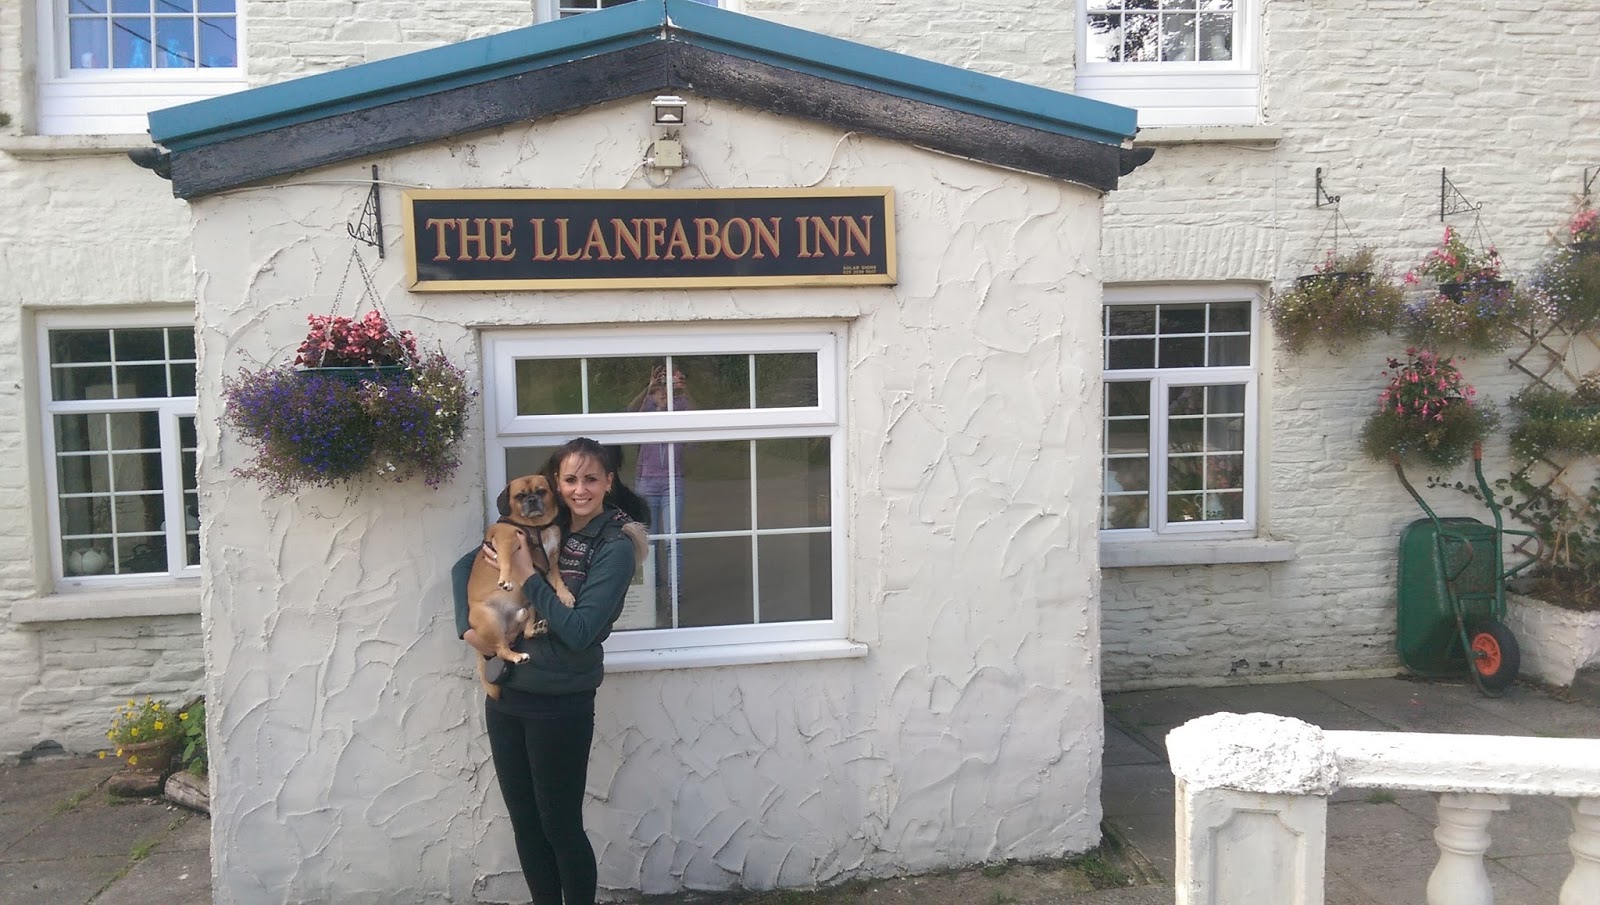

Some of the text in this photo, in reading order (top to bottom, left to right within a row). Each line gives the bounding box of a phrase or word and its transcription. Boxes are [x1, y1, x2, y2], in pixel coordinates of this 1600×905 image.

[426, 215, 873, 261] THE LLANFABON INN
